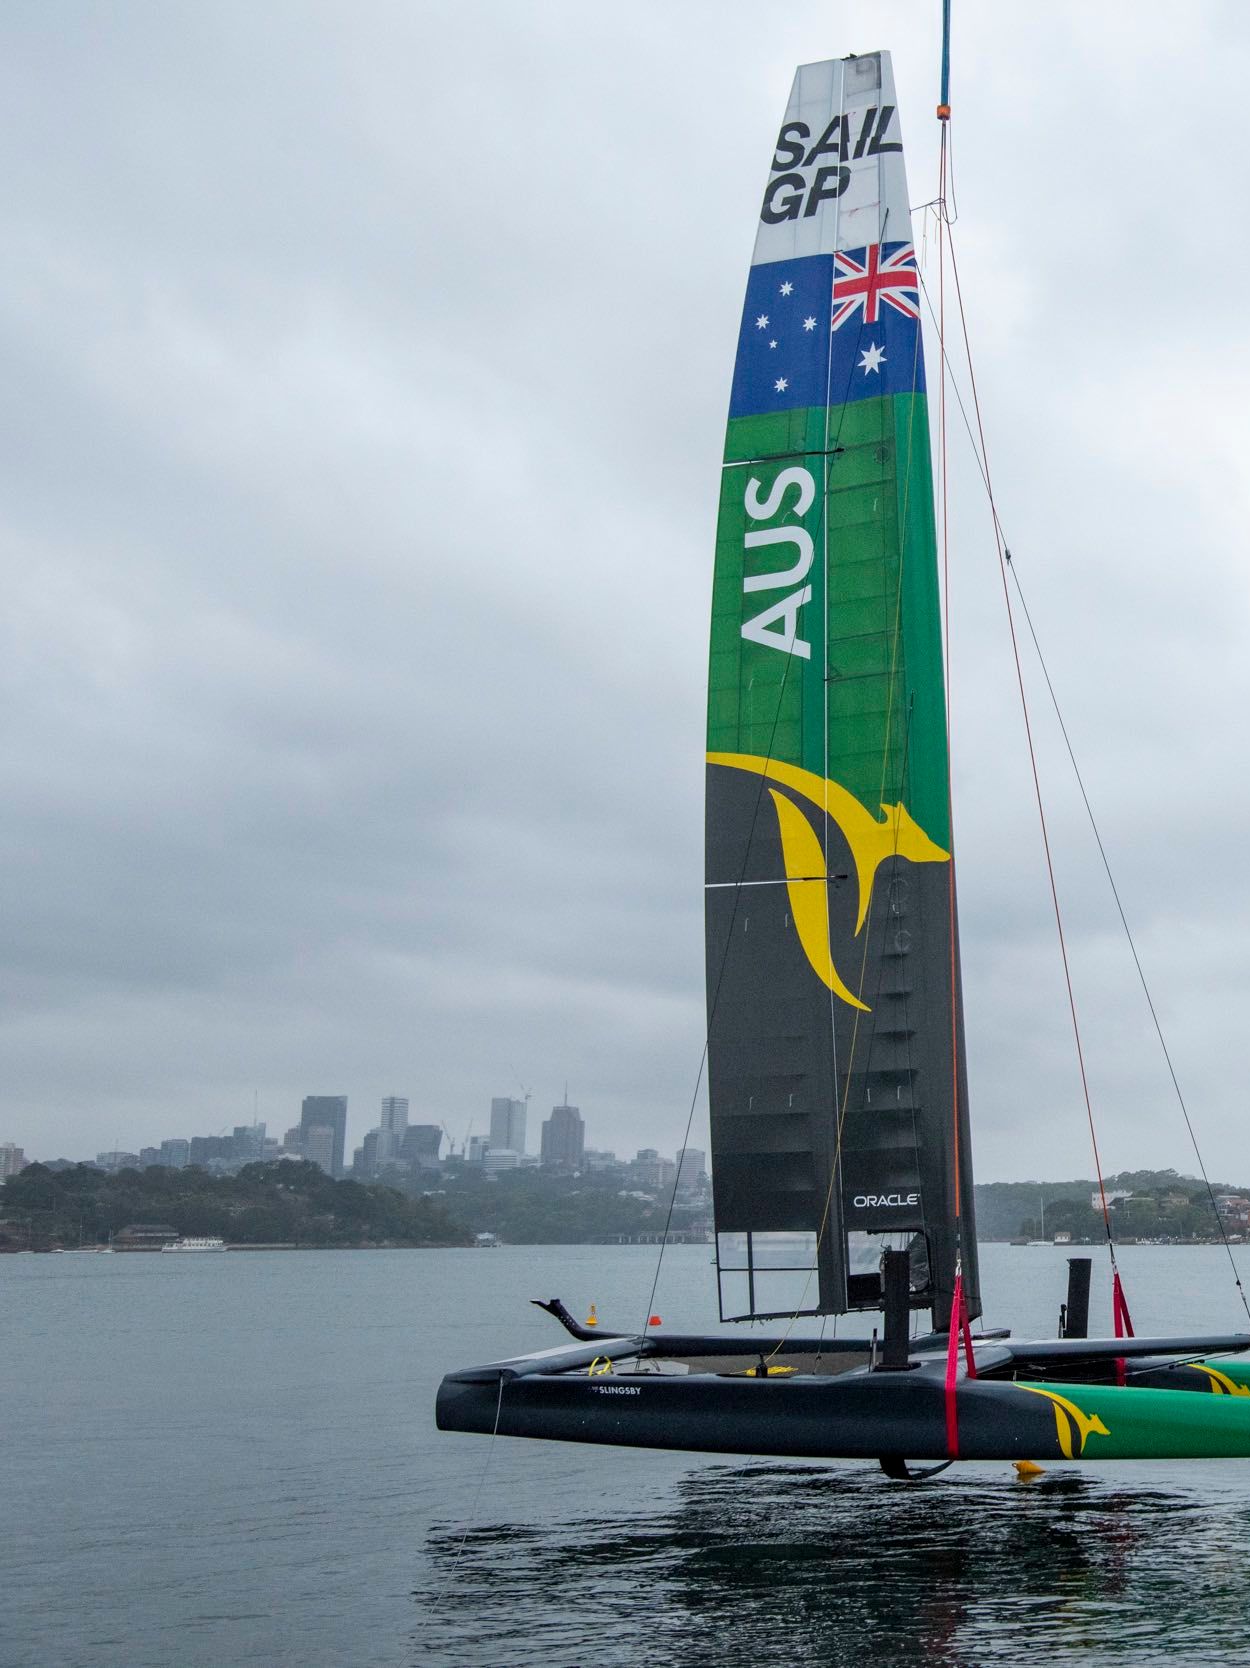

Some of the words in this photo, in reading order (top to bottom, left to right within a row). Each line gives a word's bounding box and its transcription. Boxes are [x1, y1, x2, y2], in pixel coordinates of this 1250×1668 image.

[770, 105, 903, 172] SAIL
[760, 165, 852, 225] GP
[741, 466, 816, 660] AUS
[853, 1193, 919, 1208] ORACLE
[599, 1386, 641, 1395] SLINGSBY
